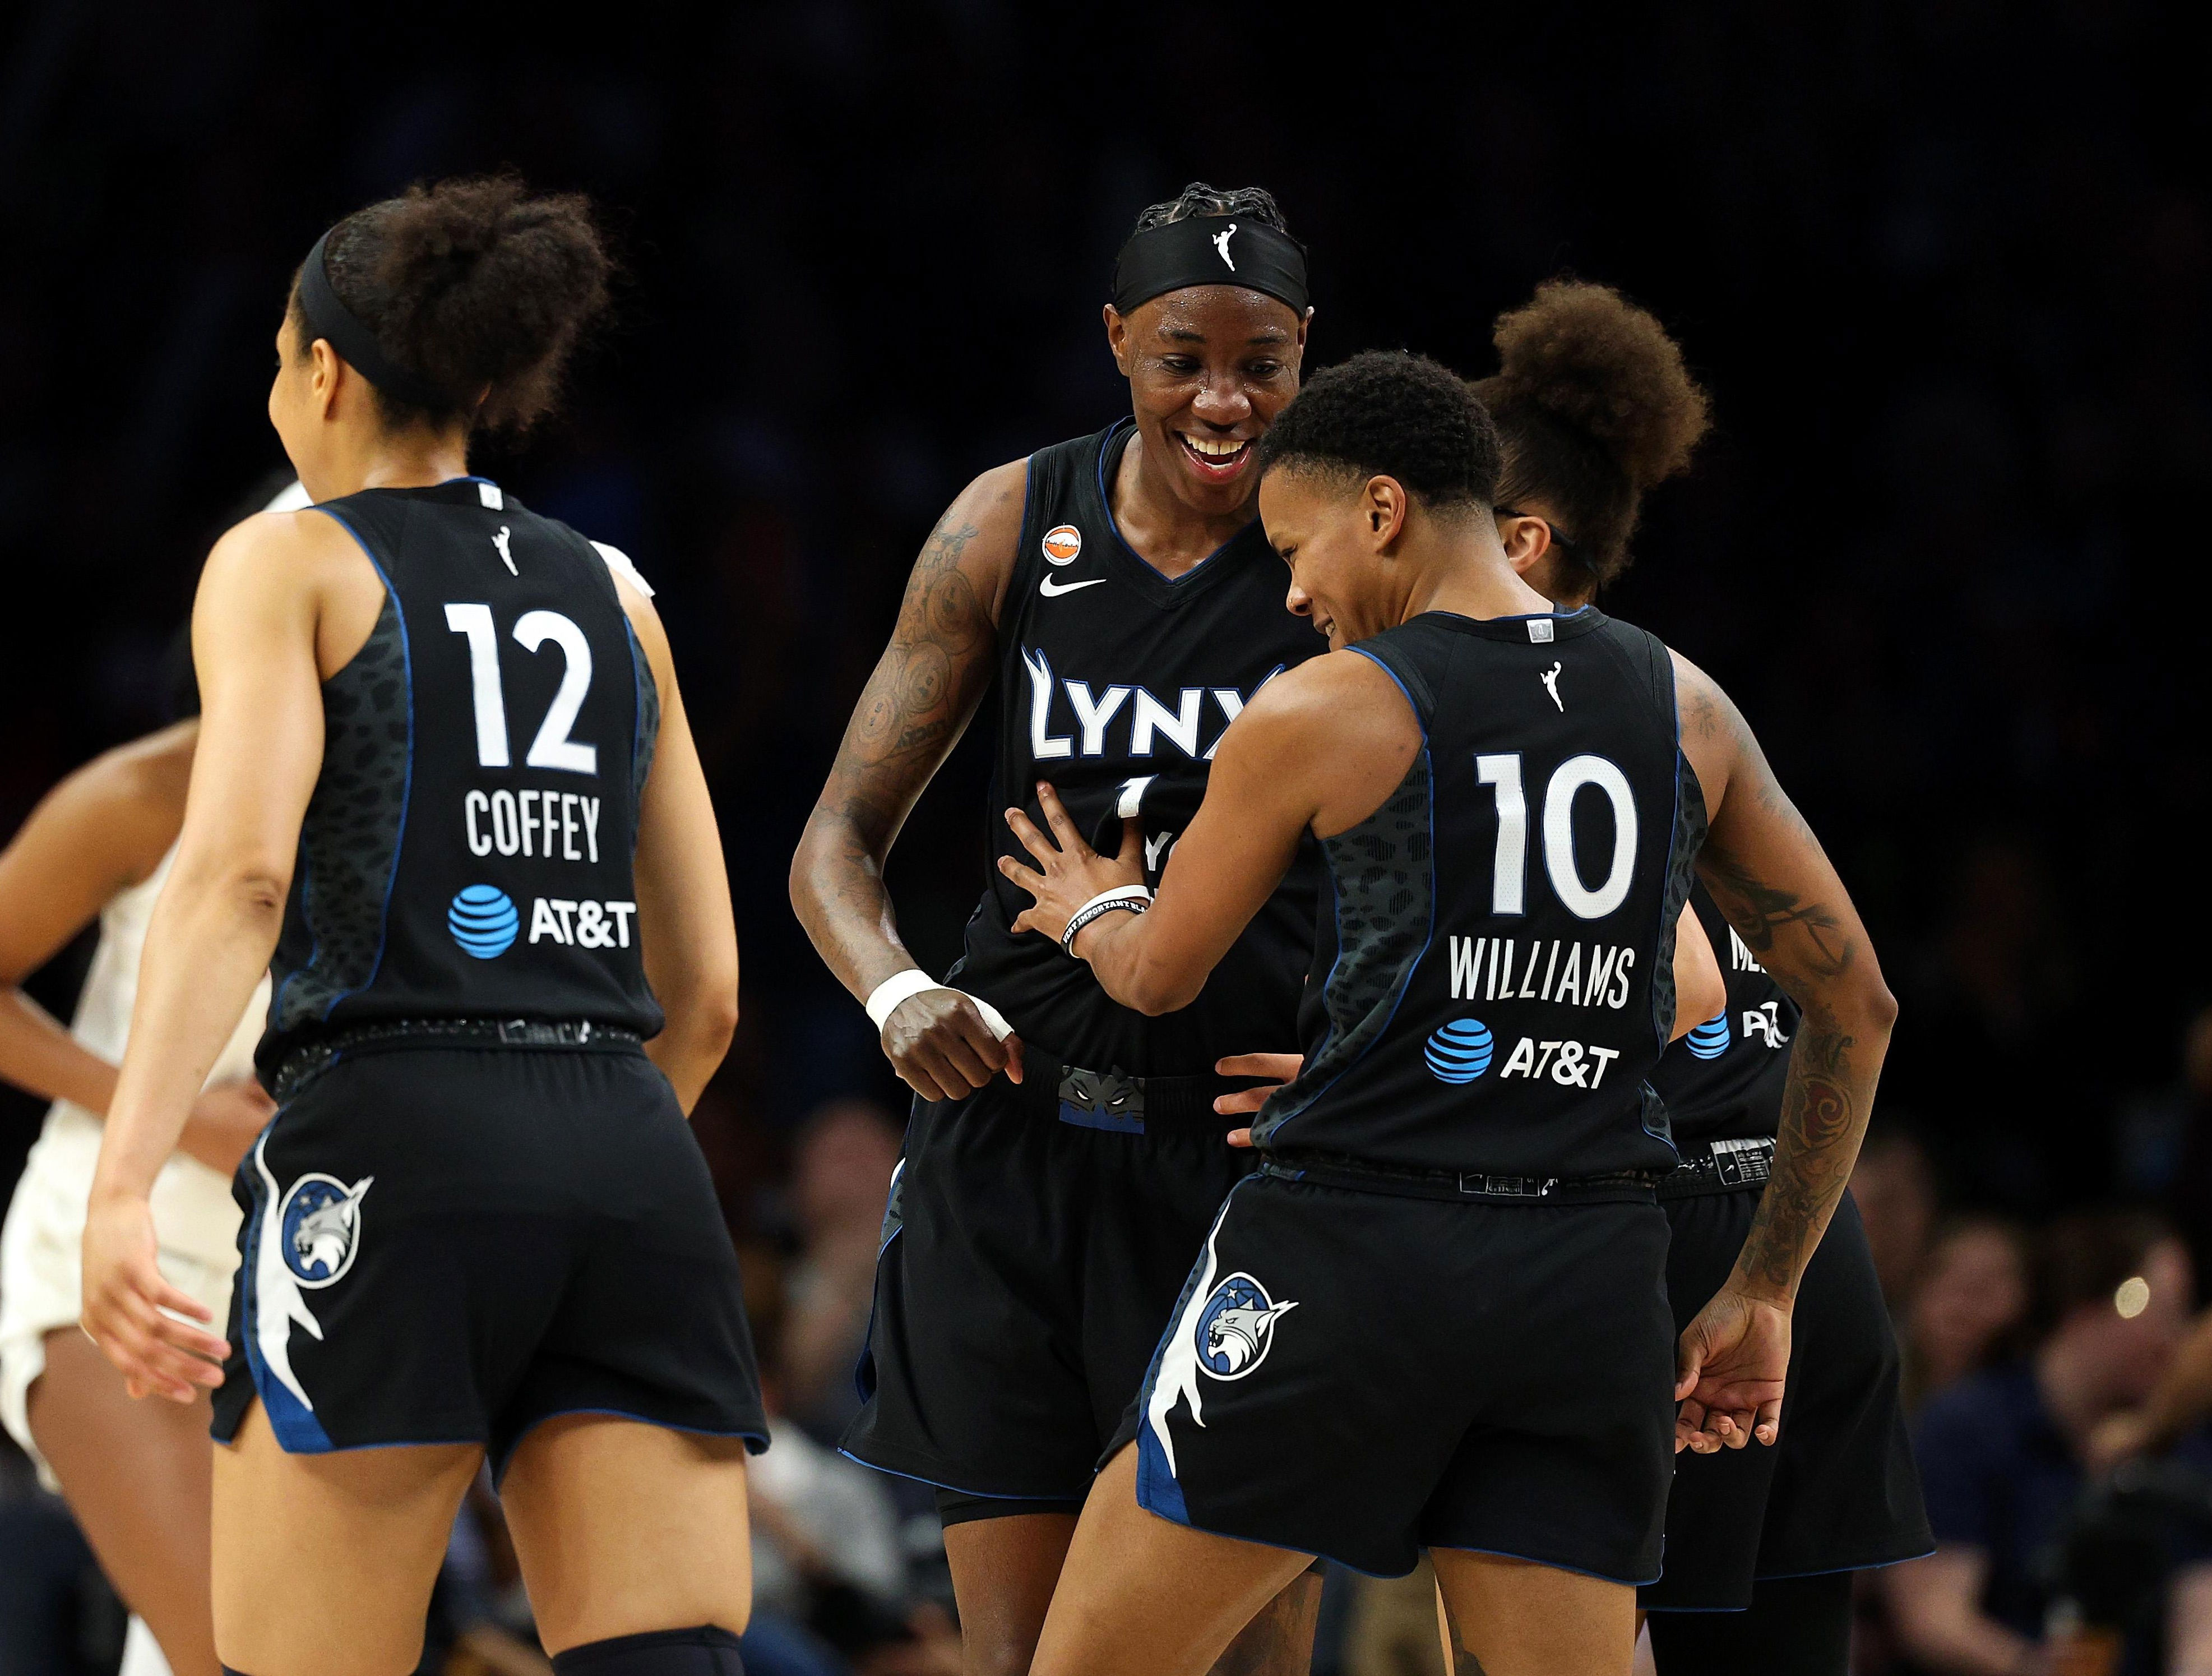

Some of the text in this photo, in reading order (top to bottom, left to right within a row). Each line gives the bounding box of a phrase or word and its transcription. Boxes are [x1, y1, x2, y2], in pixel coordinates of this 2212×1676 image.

[443, 602, 598, 776] 12
[464, 788, 600, 864] COFFEY
[1474, 751, 1639, 920] 10
[528, 897, 637, 949] AT&T
[1062, 921, 1077, 944] VERY
[1077, 901, 1130, 925] IMPORTANT
[1450, 935, 1635, 1009] WILLIAMS
[1500, 1037, 1620, 1089] AT&T
